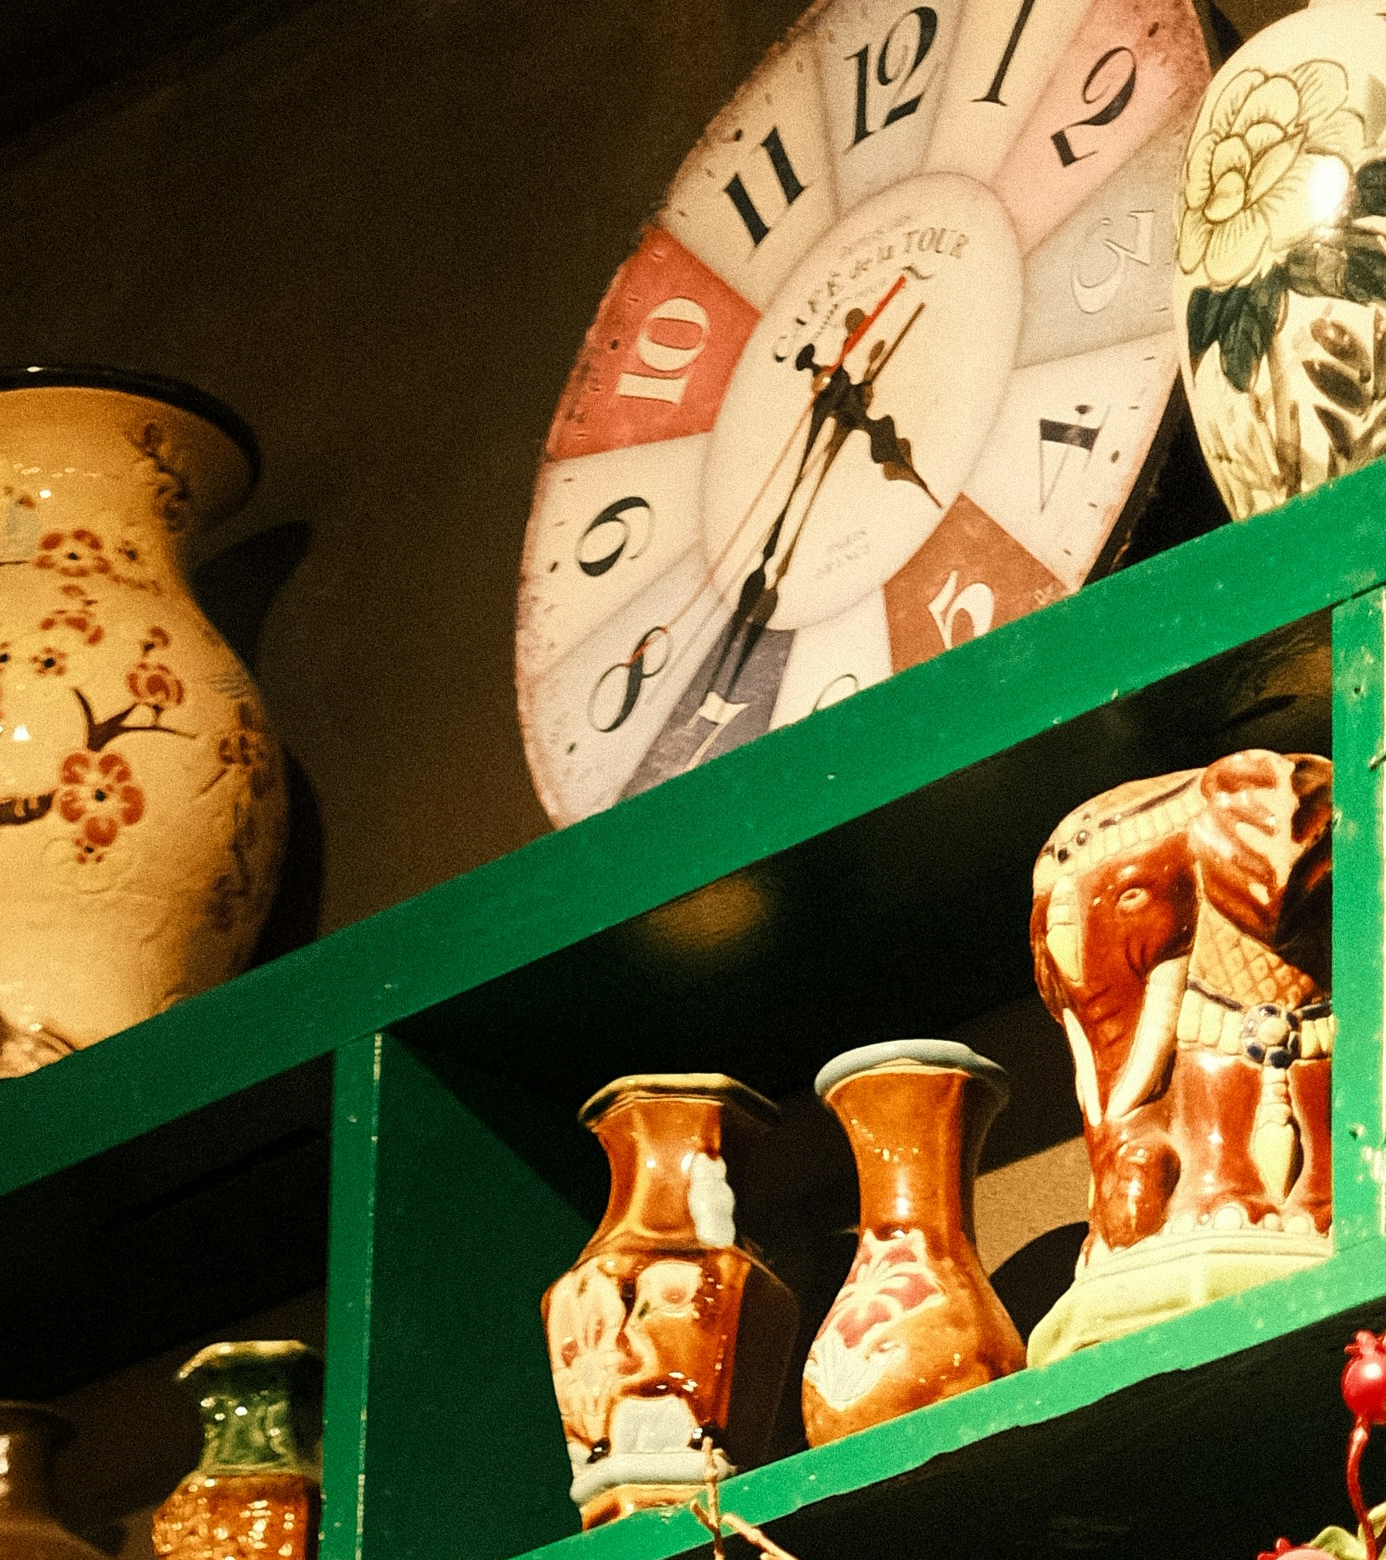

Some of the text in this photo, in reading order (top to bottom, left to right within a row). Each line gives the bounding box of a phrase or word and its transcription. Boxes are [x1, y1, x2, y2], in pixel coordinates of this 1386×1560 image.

[843, 6, 938, 154] 12
[971, 0, 1033, 106] 1
[1051, 46, 1136, 168] 2
[722, 126, 813, 262] 11
[903, 227, 969, 260] TOUR
[1070, 210, 1154, 314] 3
[617, 295, 712, 405] 10
[1039, 404, 1111, 513] 4
[575, 496, 655, 577] 9
[928, 570, 995, 649] 5
[588, 626, 673, 733] 8
[687, 691, 749, 771] 7
